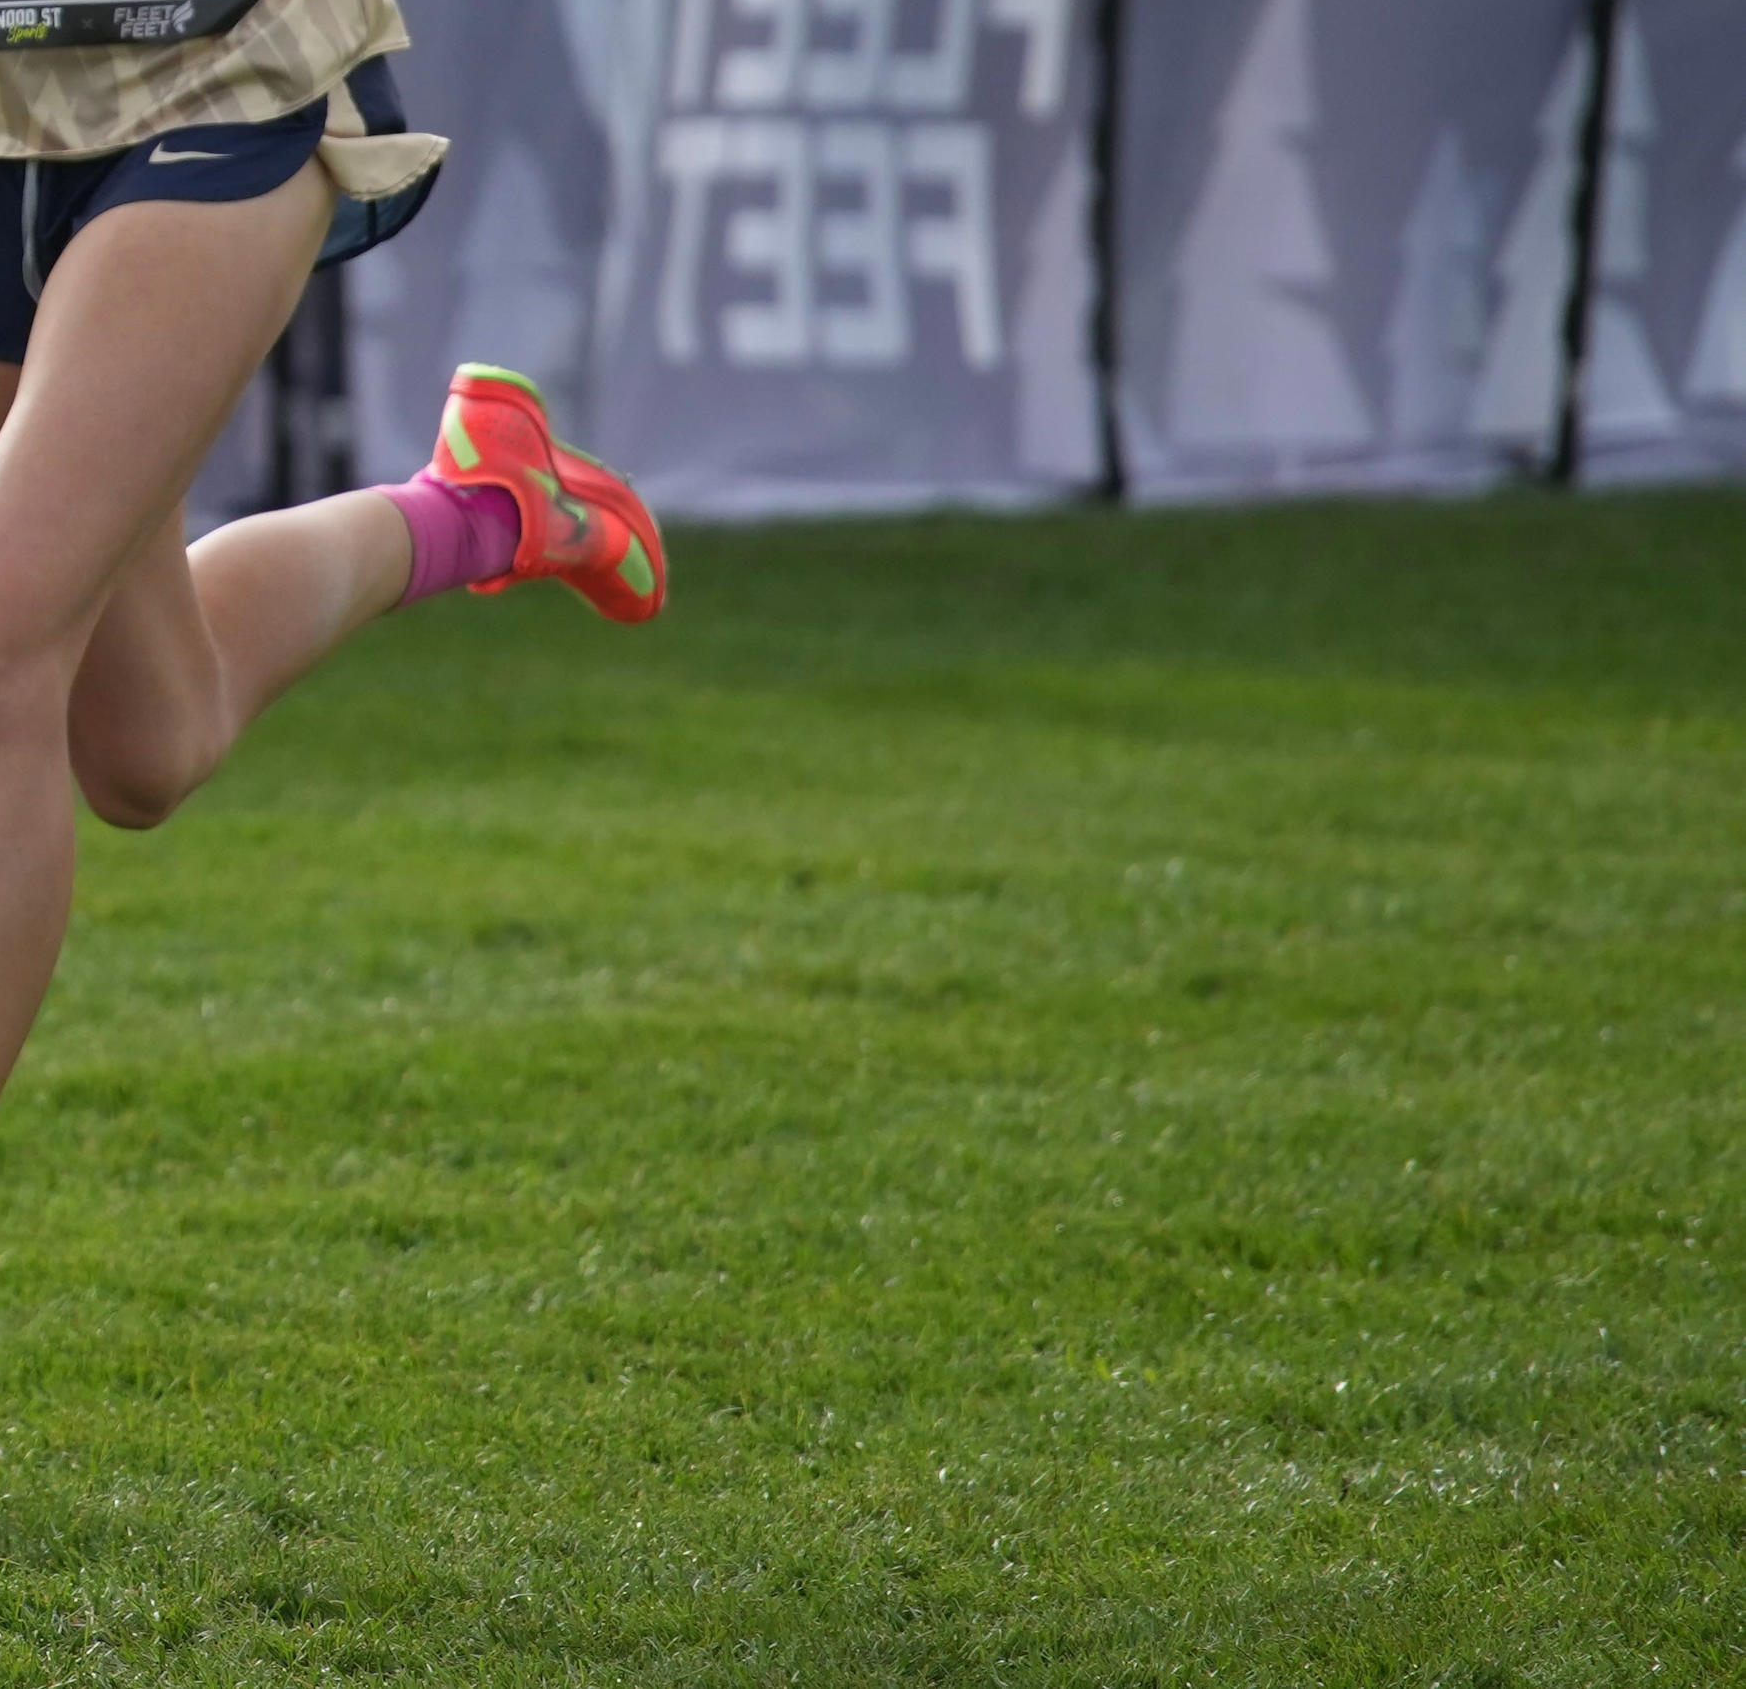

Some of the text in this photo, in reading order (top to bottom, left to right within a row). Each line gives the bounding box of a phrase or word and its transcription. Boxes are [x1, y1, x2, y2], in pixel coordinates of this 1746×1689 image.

[40, 7, 62, 29] ST
[113, 4, 175, 24] FLEET
[6, 24, 49, 44] Sports
[120, 20, 170, 39] FEET
